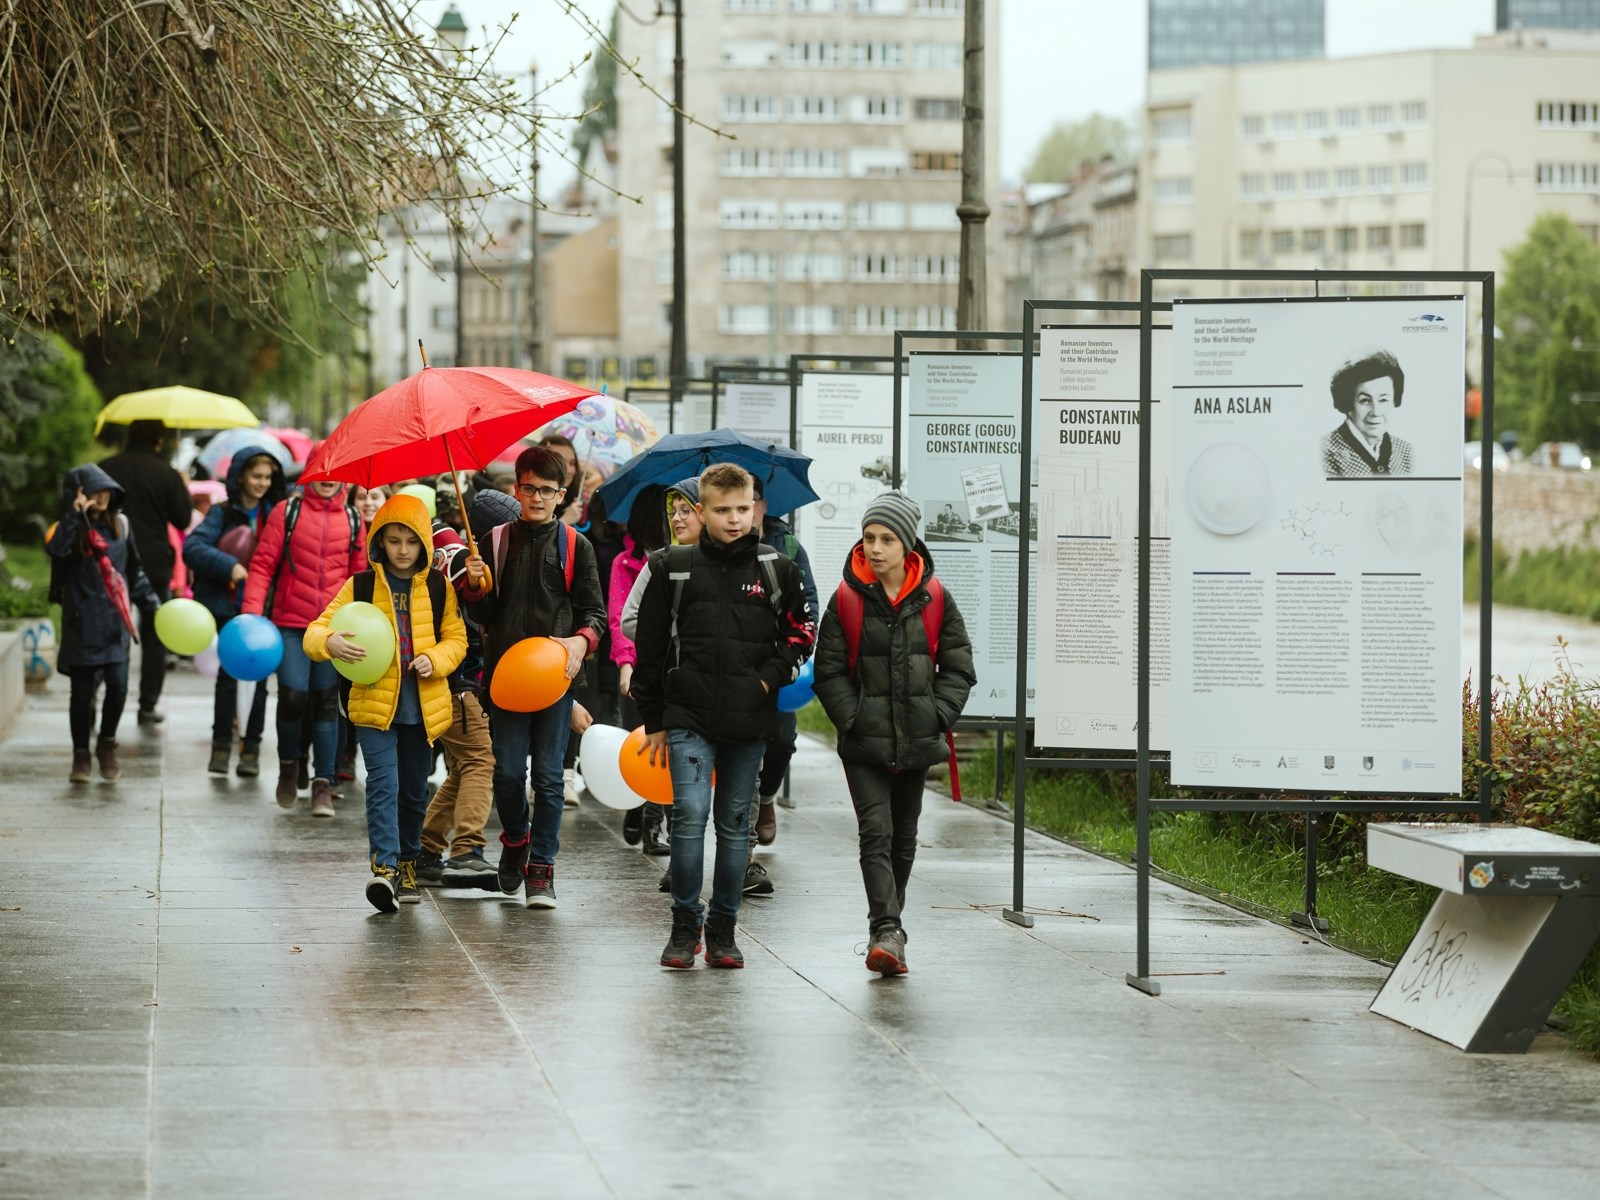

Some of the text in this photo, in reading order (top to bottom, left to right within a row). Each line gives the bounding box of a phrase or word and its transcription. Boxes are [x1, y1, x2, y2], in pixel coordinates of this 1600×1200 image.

[1194, 397, 1271, 414] ANA ASLAN
[1060, 410, 1140, 424] CONSTANTIN
[817, 433, 883, 444] AUREL PERSU
[927, 424, 1016, 439] GEORGE (GOGU)
[1060, 430, 1120, 444] BUDEANU
